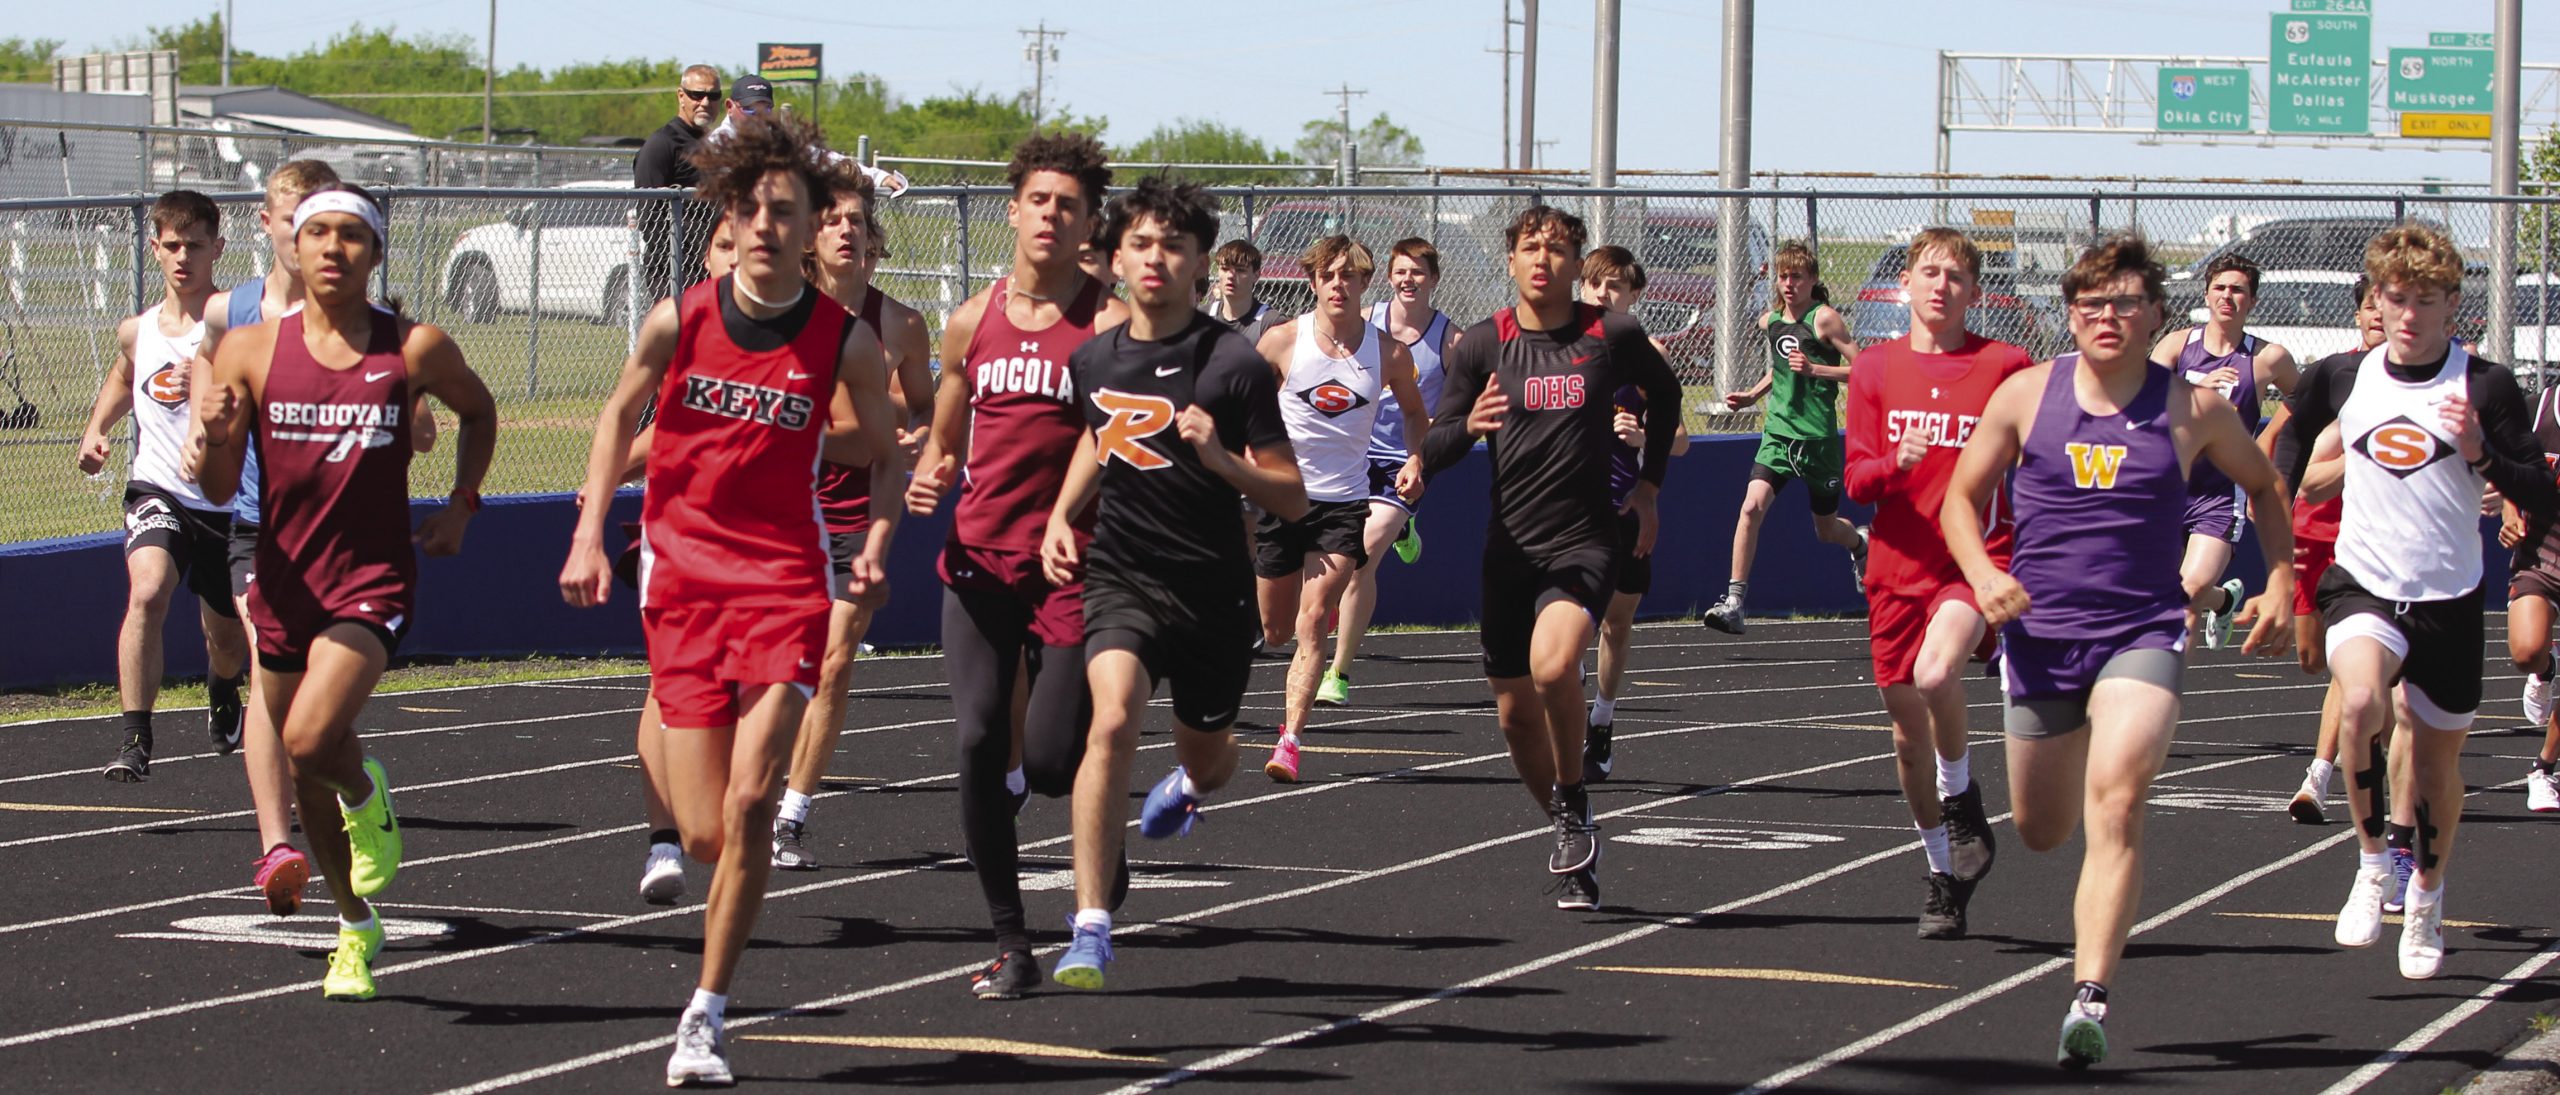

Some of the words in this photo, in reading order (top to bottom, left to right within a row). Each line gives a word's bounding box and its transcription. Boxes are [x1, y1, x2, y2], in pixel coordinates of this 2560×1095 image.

[2325, 0, 2366, 11] 264A
[2287, 26, 2307, 40] 69
[2316, 20, 2358, 30] SOUTH
[2288, 52, 2352, 67] Eufaula
[2431, 56, 2473, 67] NORTH
[2402, 61, 2421, 76] 69
[2203, 75, 2236, 87] WEST
[2277, 72, 2361, 87] McAlester
[2176, 81, 2193, 97] 40
[2293, 93, 2345, 107] Dallas
[2394, 91, 2475, 108] Muskogee
[2164, 110, 2202, 124] Okla
[2208, 110, 2243, 127] City
[2318, 116, 2342, 125] MILE
[2410, 119, 2437, 130] EXIT
[2448, 120, 2480, 131] ONLY
[977, 357, 1073, 404] POCOLA
[1315, 385, 1350, 412] S
[1525, 374, 1585, 411] OHS
[682, 373, 813, 431] KEYS
[269, 402, 400, 427] SEQUOYAH
[1089, 386, 1175, 471] R
[1887, 410, 1982, 449] STIGLE
[2374, 427, 2427, 467] S
[2065, 442, 2127, 489] W
